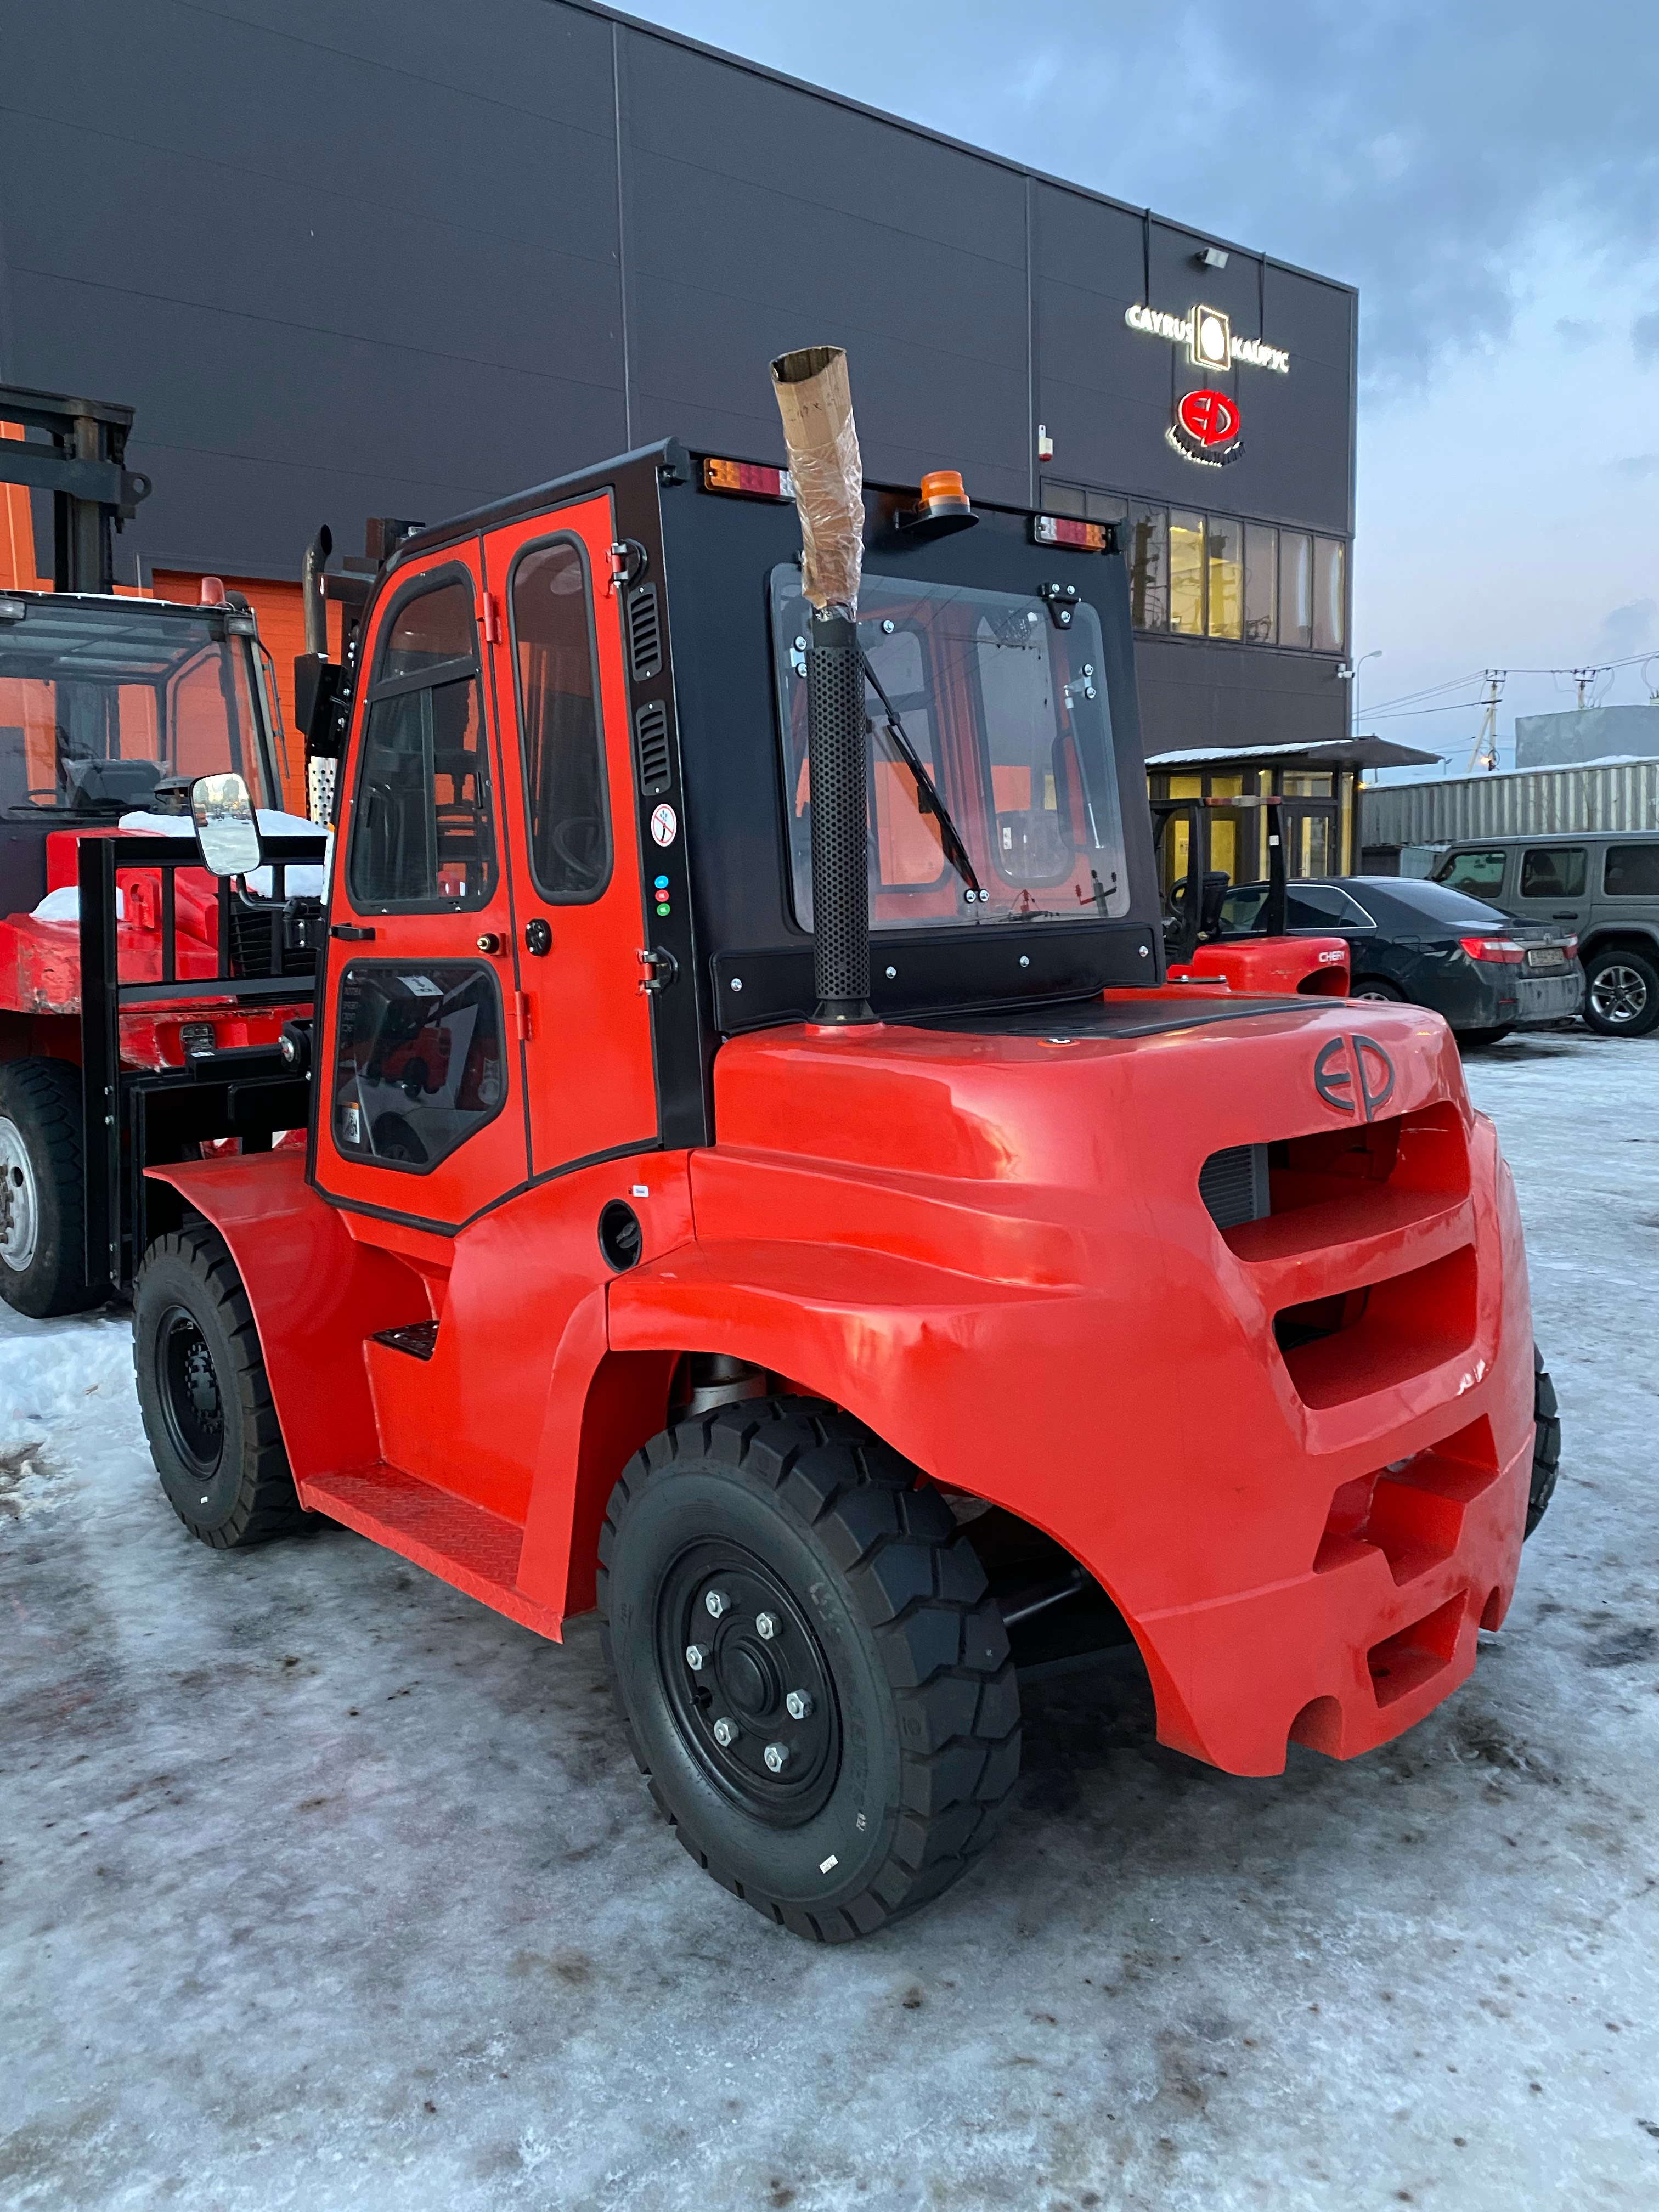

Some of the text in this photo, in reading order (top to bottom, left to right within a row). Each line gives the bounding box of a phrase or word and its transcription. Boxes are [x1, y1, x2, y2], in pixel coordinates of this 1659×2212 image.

[1126, 304, 1193, 343] CAYRUS
[1231, 337, 1290, 373] КАЙРУС
[1318, 950, 1345, 963] CHERY
